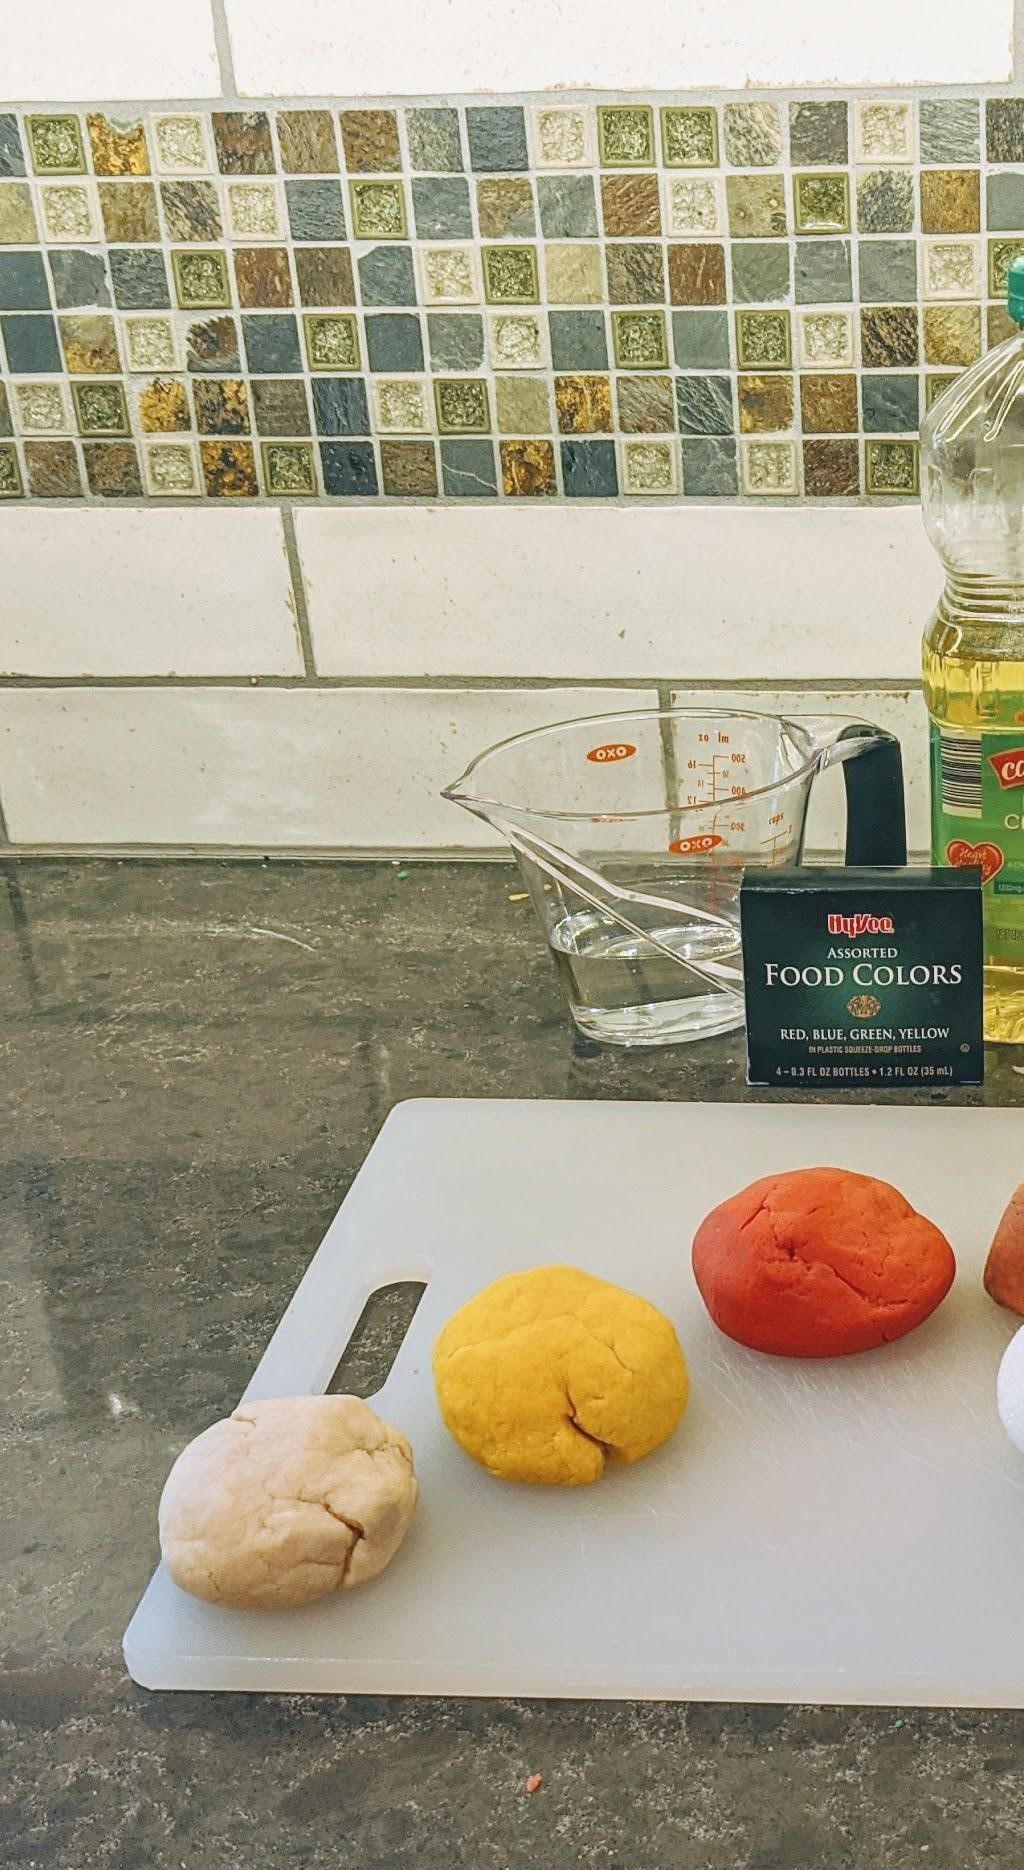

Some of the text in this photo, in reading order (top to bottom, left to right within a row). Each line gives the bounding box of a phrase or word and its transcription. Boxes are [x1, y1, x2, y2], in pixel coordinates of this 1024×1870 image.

[596, 746, 627, 760] OXO
[827, 948, 898, 959] ASSORTED
[764, 963, 962, 986] FOOD COLORS
[780, 1027, 950, 1041] RED, BLUE, GREEN, YELLOW
[817, 1045, 844, 1053] PLASTIC
[893, 1045, 922, 1053] BOTTLES
[776, 1067, 781, 1076] 4
[791, 1067, 805, 1077] 0.3
[807, 1067, 818, 1077] FL
[820, 1067, 831, 1077] OZ
[833, 1067, 870, 1077] BOTTLES
[879, 1067, 893, 1077] 1.2
[894, 1067, 905, 1076] FL
[907, 1066, 918, 1076] OZ
[921, 1066, 935, 1077] (35
[936, 1066, 953, 1077] mL)
